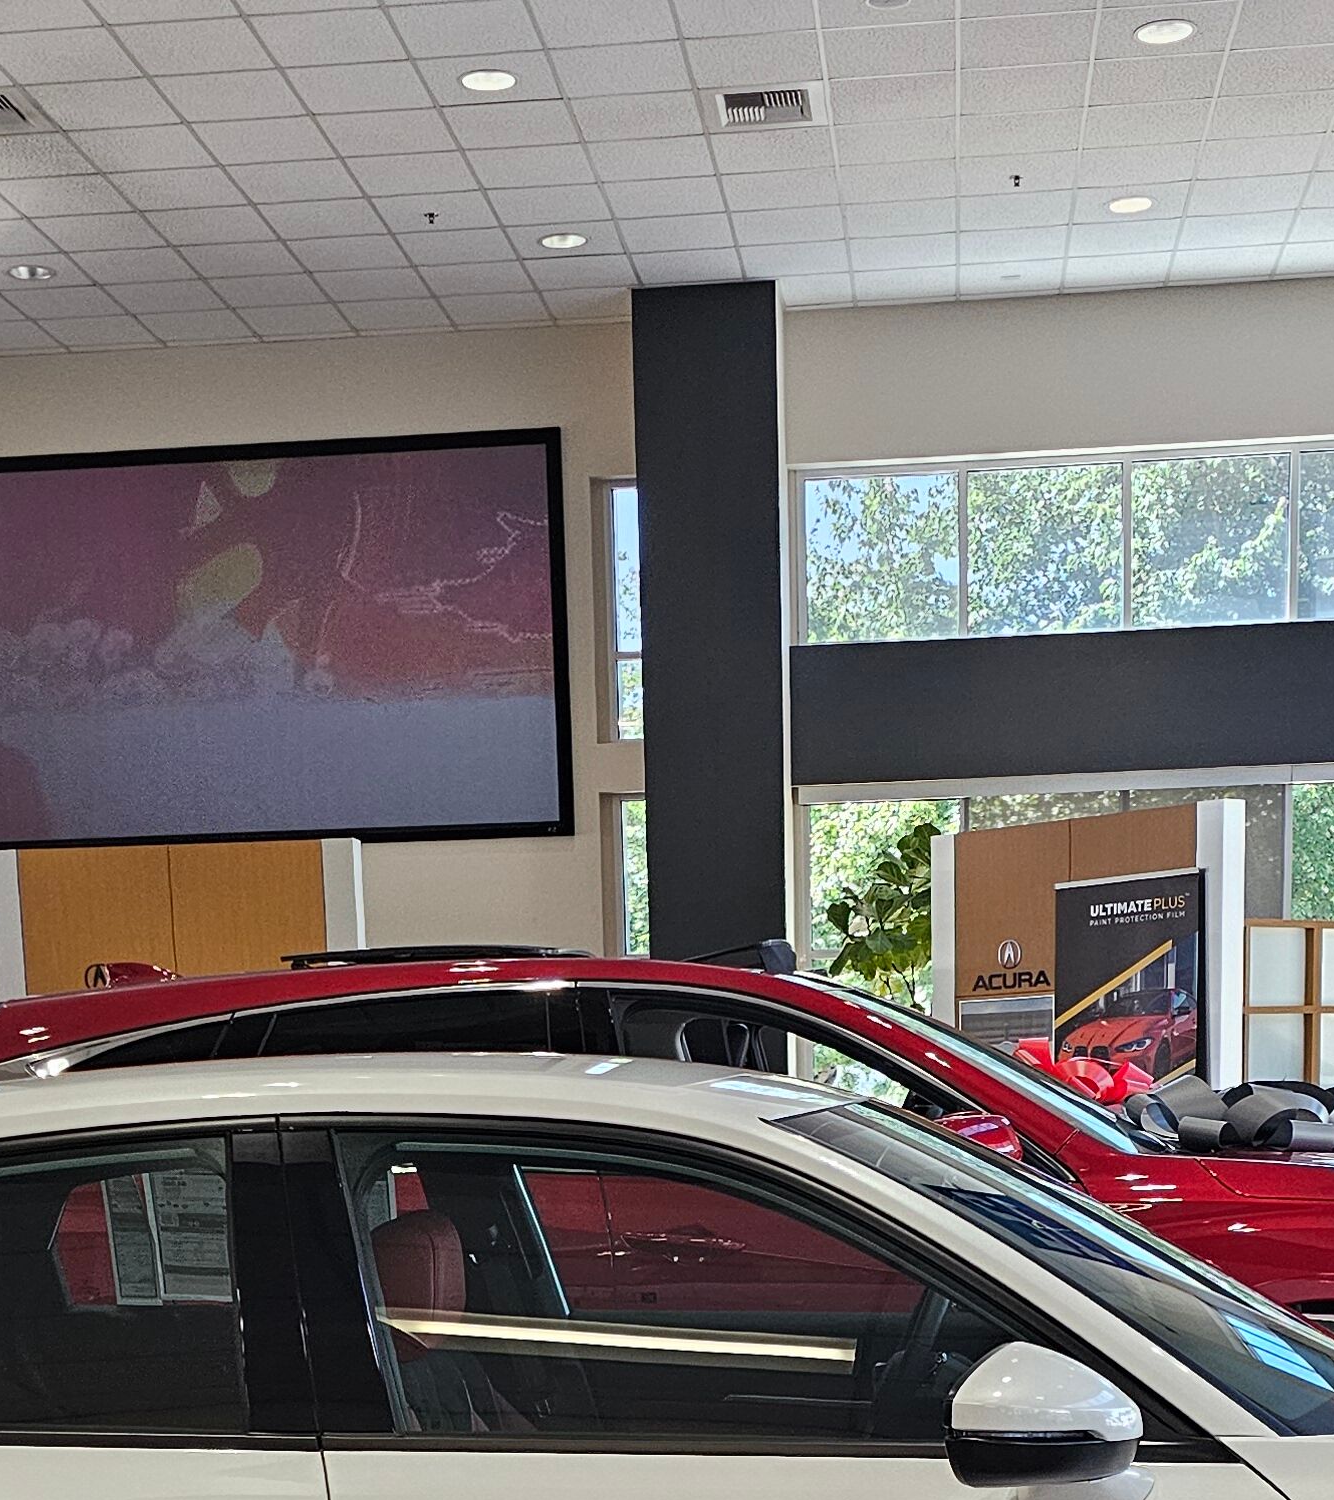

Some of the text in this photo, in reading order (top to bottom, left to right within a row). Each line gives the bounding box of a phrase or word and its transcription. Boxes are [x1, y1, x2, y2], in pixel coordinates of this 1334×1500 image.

[1089, 910, 1186, 927] PAINT PROTECTION FILM
[971, 969, 1052, 992] ACURA
